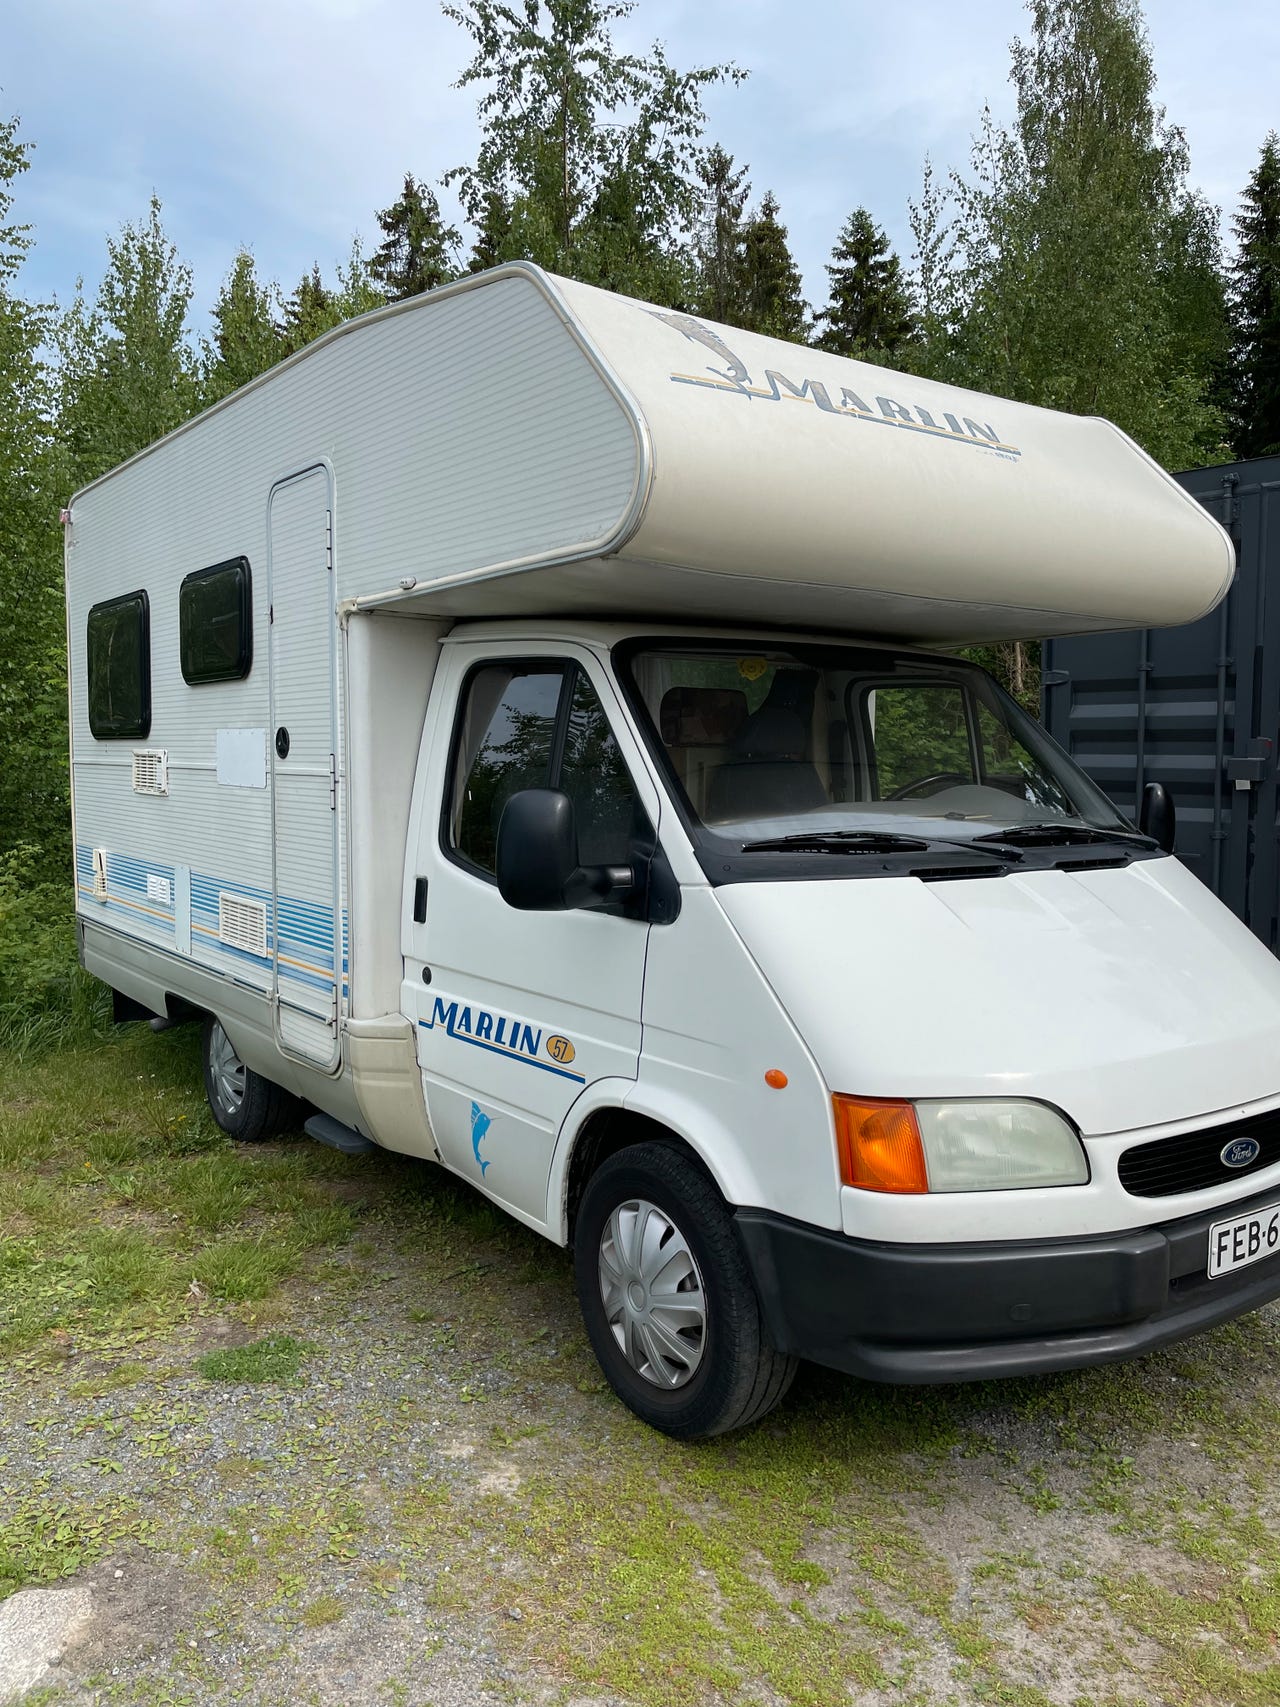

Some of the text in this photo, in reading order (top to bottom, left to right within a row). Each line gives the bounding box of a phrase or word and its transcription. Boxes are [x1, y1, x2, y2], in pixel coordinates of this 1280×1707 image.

[764, 369, 1000, 443] MARLIN
[431, 997, 568, 1060] MARLIN 57
[1231, 1144, 1252, 1162] Ford
